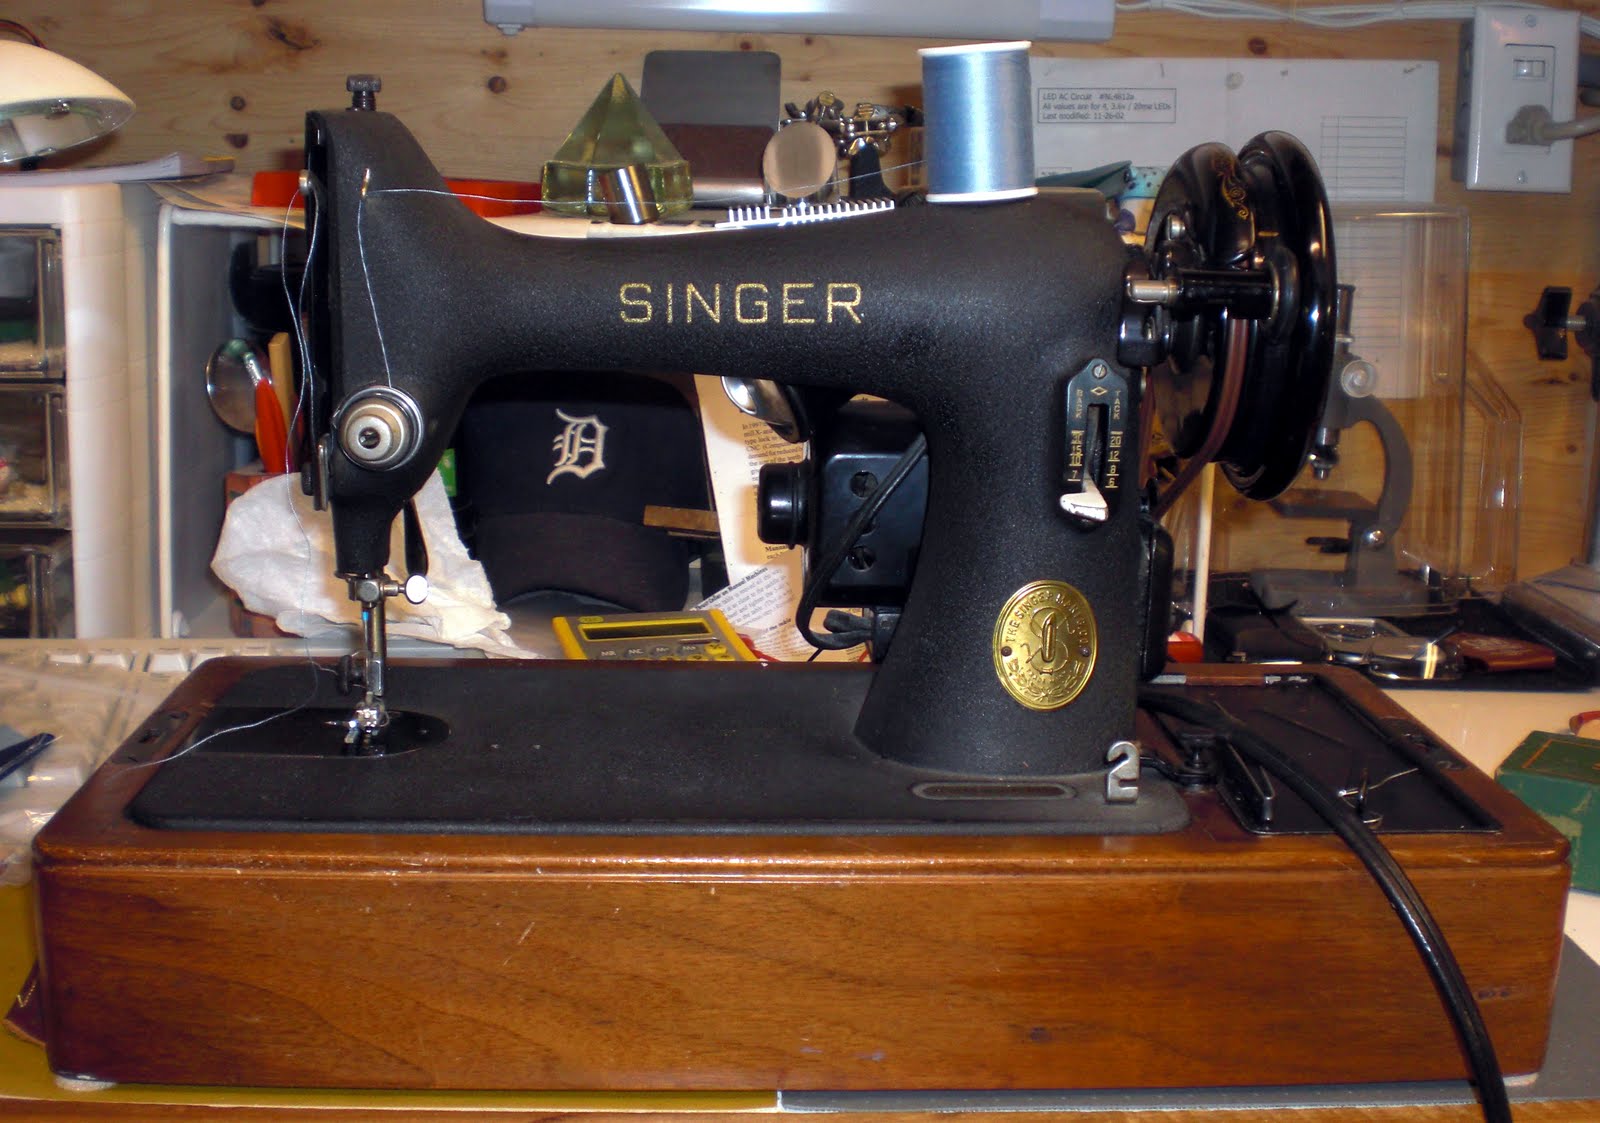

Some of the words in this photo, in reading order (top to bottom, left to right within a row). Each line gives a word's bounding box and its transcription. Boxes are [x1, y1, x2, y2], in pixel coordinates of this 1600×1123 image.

[1043, 92, 1057, 101] LED
[1058, 92, 1069, 101] AC
[1070, 92, 1092, 101] Circuit
[1042, 102, 1051, 110] All
[1054, 102, 1075, 110] values
[1090, 102, 1101, 110] for
[1154, 102, 1172, 110] LEDs
[1043, 112, 1057, 120] Last
[1058, 112, 1091, 120] modified:
[619, 283, 862, 324] SINGER
[1075, 388, 1084, 419] BACK
[1113, 390, 1121, 420] TACK
[1110, 436, 1122, 447] 20
[546, 408, 610, 485] D
[1072, 445, 1082, 454] 15
[1071, 455, 1081, 464] 10
[1109, 451, 1120, 460] 12
[1110, 465, 1117, 474] 8
[1072, 470, 1078, 479] 7
[1108, 478, 1115, 486] 6
[728, 578, 745, 591] Manual
[745, 567, 768, 581] Machines
[1005, 621, 1020, 643] THE
[1015, 590, 1053, 620] SINGER
